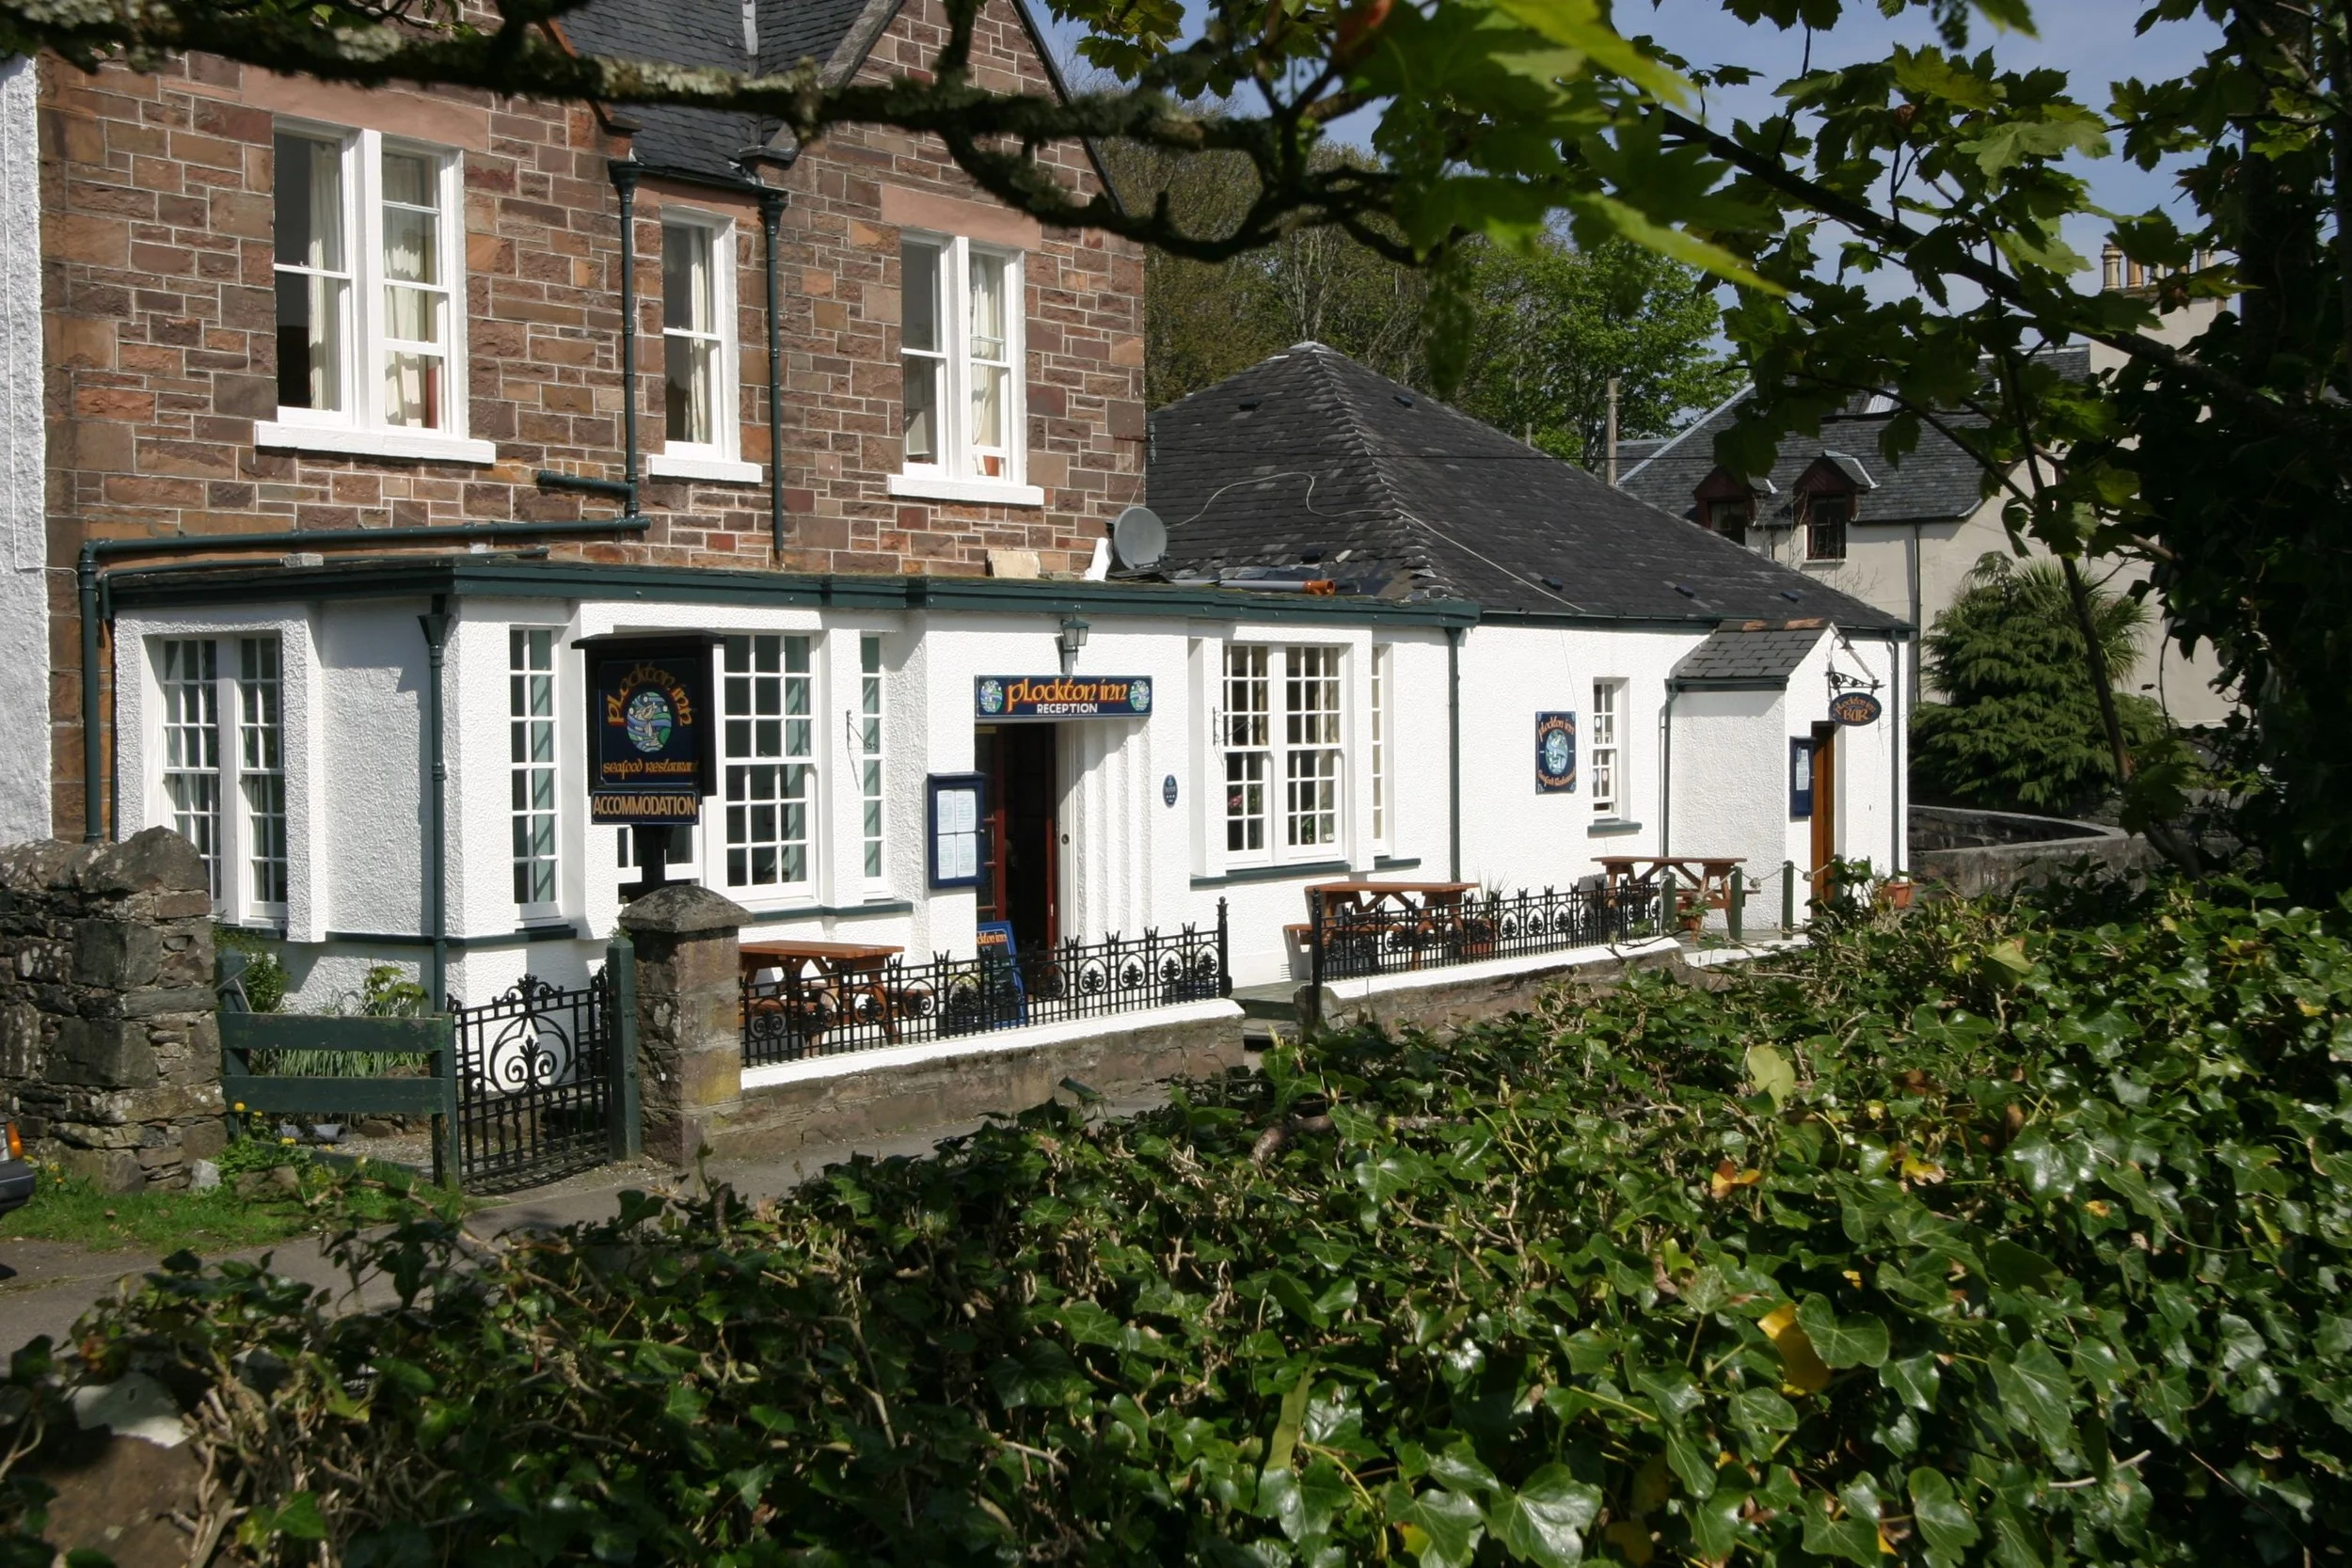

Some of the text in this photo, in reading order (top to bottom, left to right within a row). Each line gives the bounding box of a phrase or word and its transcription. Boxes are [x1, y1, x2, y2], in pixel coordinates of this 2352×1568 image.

[1037, 704, 1098, 715] RECEPTION
[603, 758, 644, 780] seafood
[593, 796, 696, 816] ACCOMMODATION
